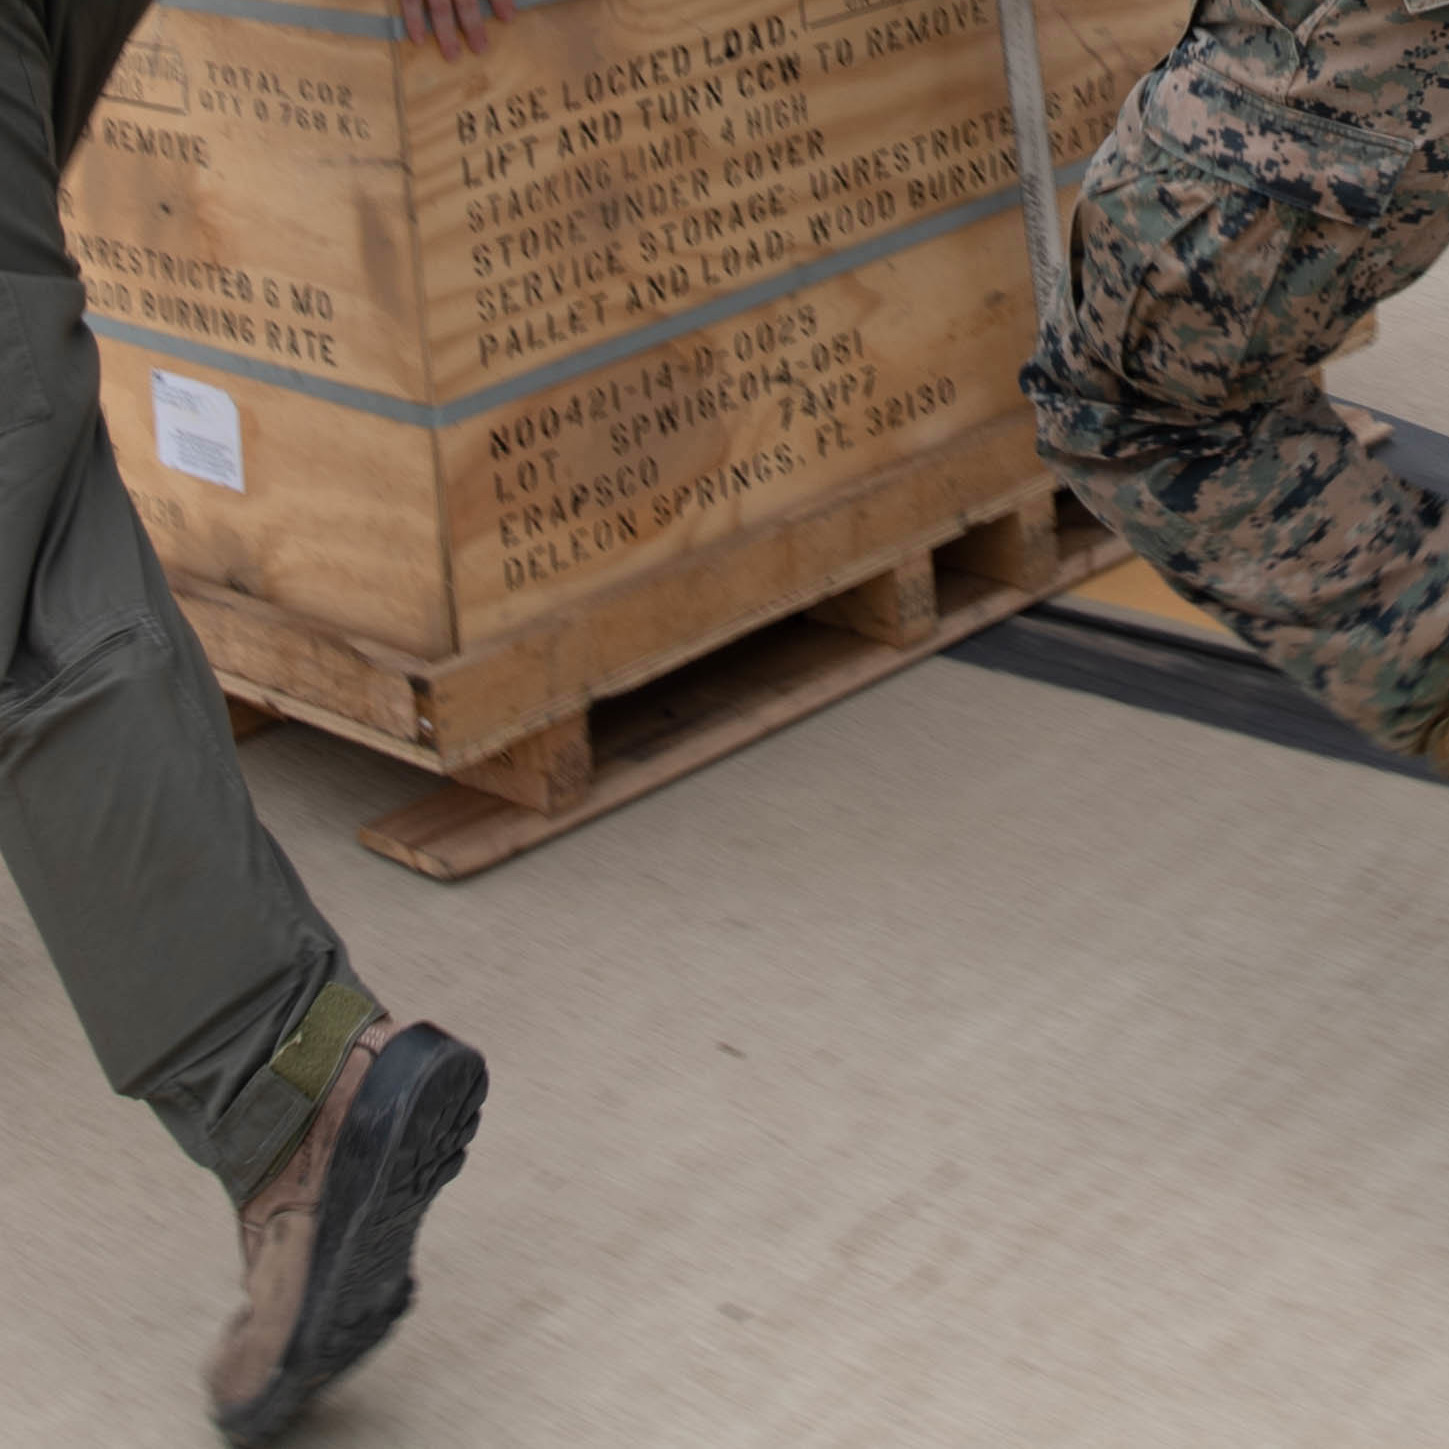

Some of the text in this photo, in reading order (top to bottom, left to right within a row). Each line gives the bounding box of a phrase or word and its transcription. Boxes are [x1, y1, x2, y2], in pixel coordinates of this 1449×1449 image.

[204, 59, 290, 101] TOTAL
[456, 85, 550, 146] BASE
[562, 44, 692, 112] LOCKED
[461, 134, 538, 190] LIFT
[557, 110, 624, 159] AND
[635, 75, 724, 131] TURN
[735, 50, 802, 100] CCW
[813, 37, 852, 73] TO
[103, 116, 209, 171] REMOVE
[466, 157, 613, 234] STACKING
[744, 92, 810, 141] HIGH
[471, 127, 826, 279] STORE UNDER COVER
[475, 240, 626, 325] SERVICE
[808, 104, 1017, 203] UNRESTRICTE
[289, 280, 335, 323] MO
[478, 291, 608, 369] PALLET
[625, 262, 691, 315] AND
[806, 188, 898, 246] WOOD
[908, 146, 1018, 210] BURNIN
[84, 275, 339, 369] OOD BURNING RATE
[492, 447, 561, 506] LOT
[496, 454, 660, 551] ERAPSCO
[501, 505, 640, 592] DELEON
